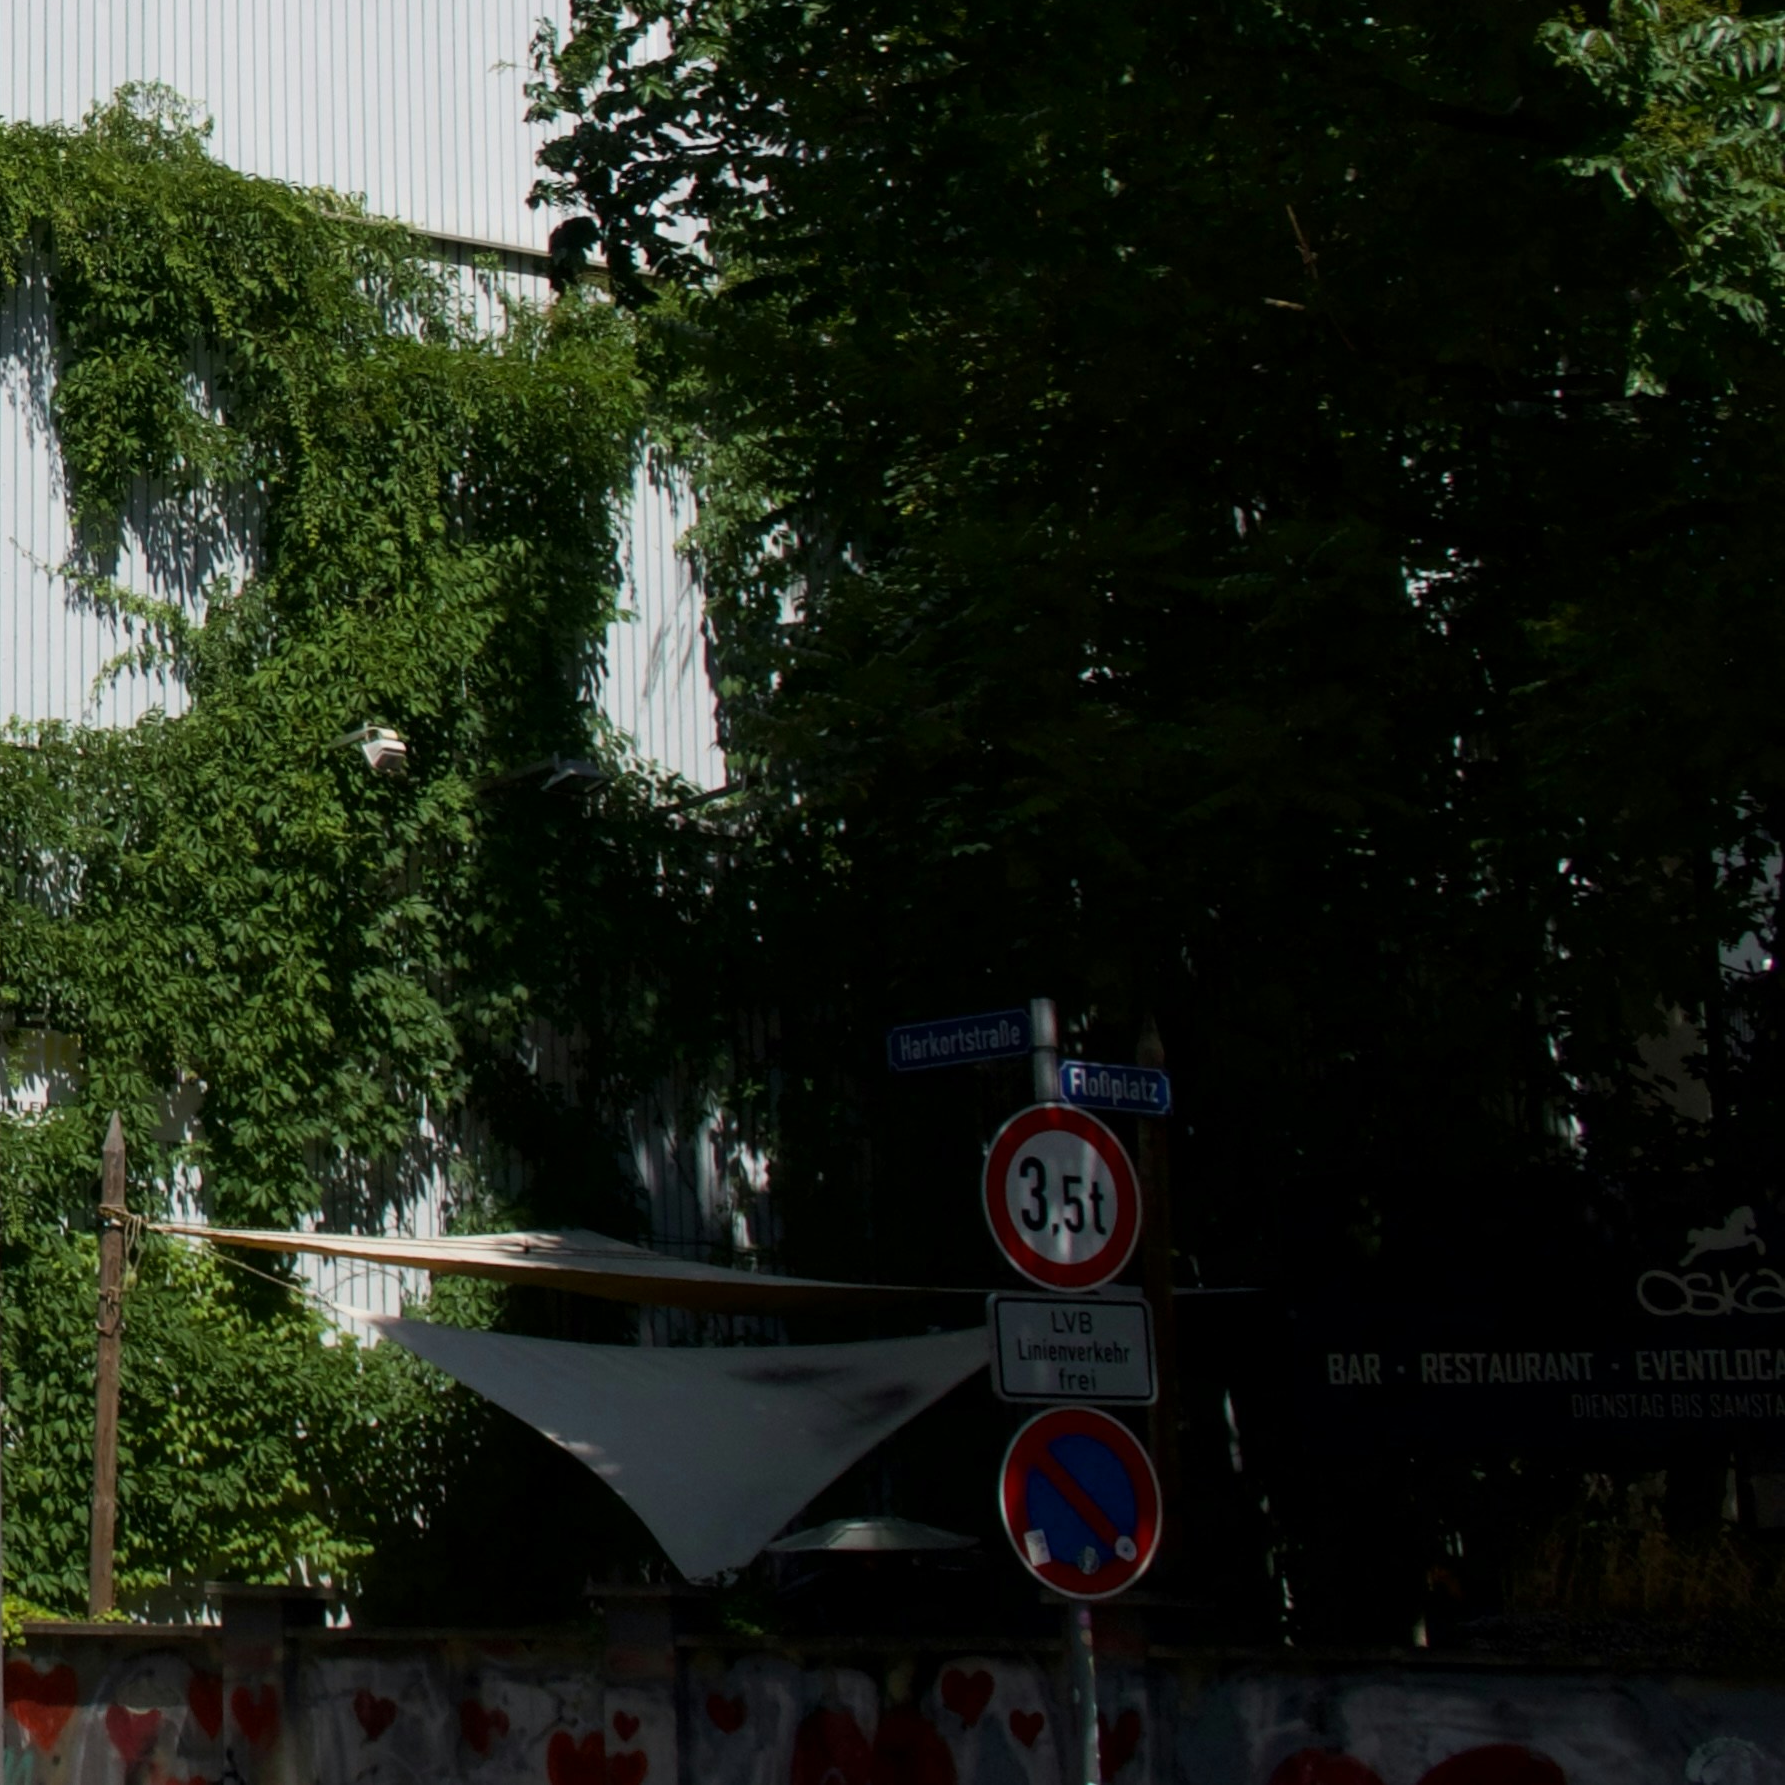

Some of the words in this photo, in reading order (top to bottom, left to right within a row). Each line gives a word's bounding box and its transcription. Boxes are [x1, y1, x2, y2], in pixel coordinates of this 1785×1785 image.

[899, 1019, 1022, 1061] Harkortstraße
[1068, 1067, 1160, 1106] Floßplatz
[1051, 1311, 1093, 1334] LVB
[1018, 1338, 1130, 1363] Linienverkehr
[1058, 1368, 1097, 1392] frei
[1327, 1352, 1382, 1385] BAR
[1420, 1351, 1595, 1384] RESTAURANT
[1571, 1391, 1665, 1418] DIENSTAG
[1671, 1391, 1703, 1419] BIS
